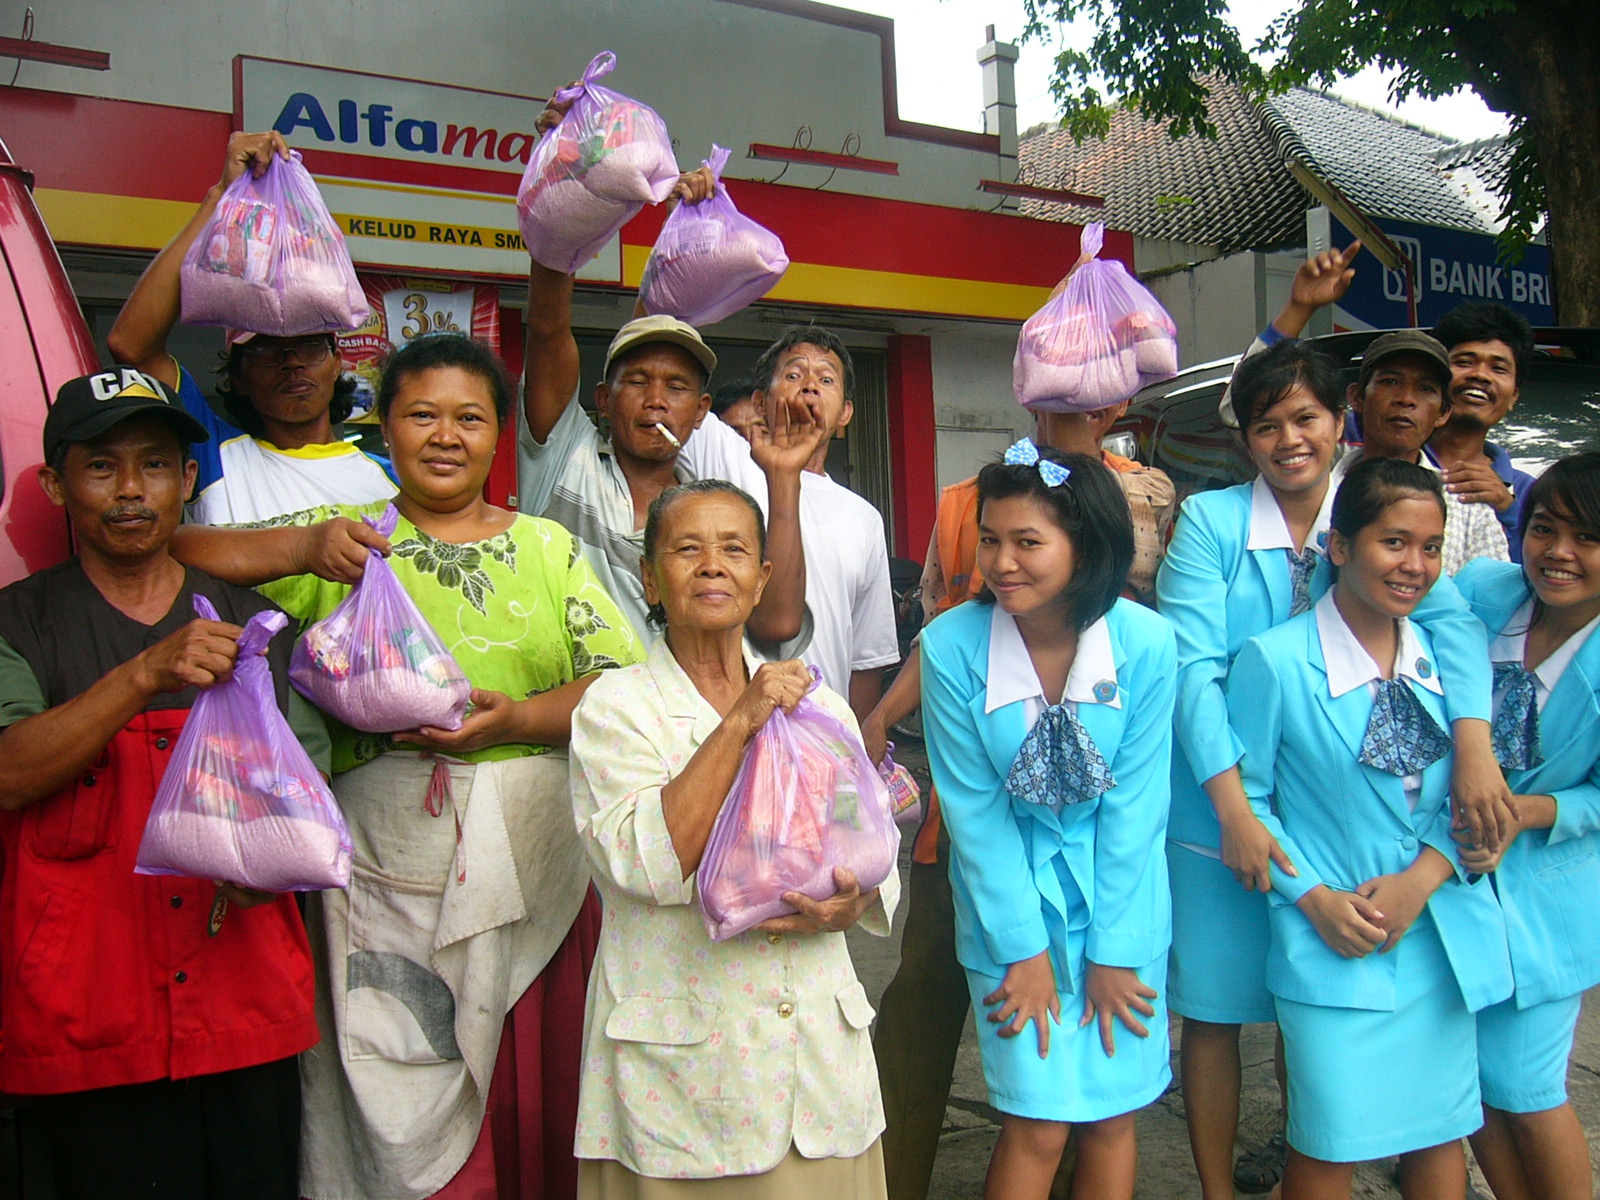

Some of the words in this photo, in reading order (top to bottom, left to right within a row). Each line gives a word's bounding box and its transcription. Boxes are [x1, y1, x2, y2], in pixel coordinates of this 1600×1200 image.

[349, 218, 417, 240] KELUD
[429, 225, 483, 247] RAYA
[1429, 257, 1505, 300] BANK
[1511, 270, 1551, 306] BRI
[401, 293, 460, 340] 3%
[338, 338, 364, 348] CASH
[90, 368, 170, 405] CAT
